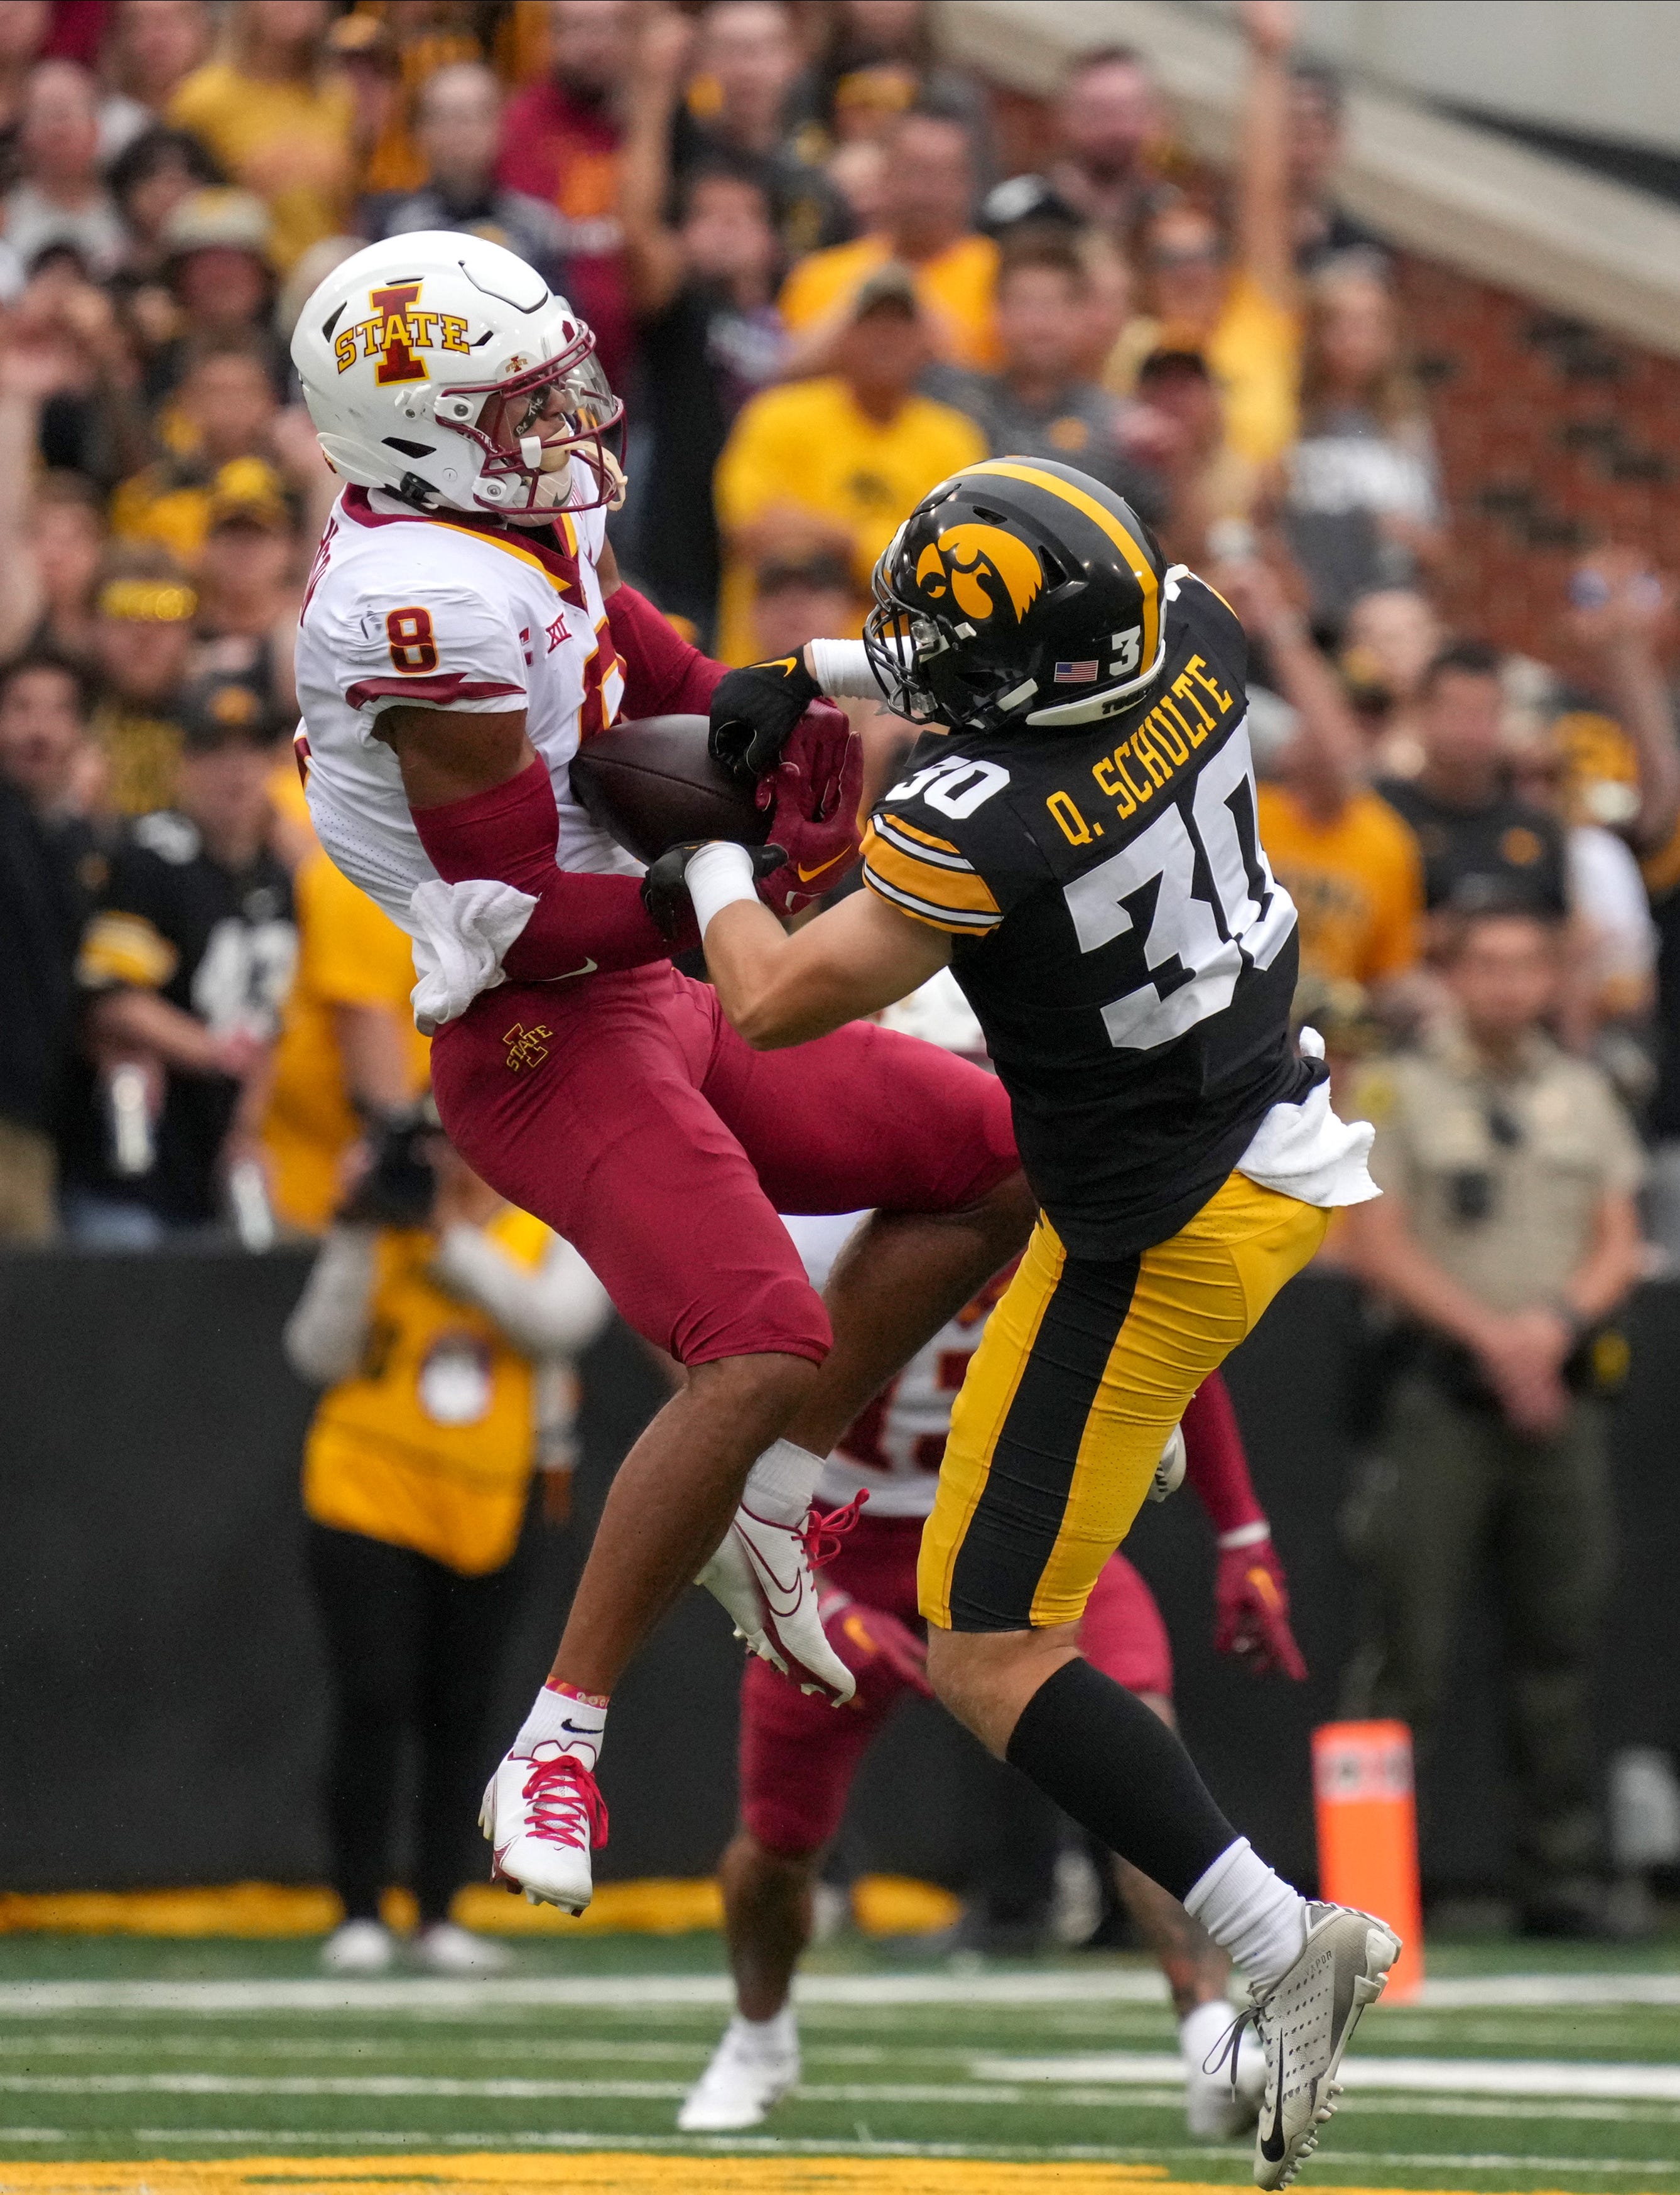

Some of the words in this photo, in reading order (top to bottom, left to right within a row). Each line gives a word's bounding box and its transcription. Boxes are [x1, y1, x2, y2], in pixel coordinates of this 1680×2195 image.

[335, 312, 470, 374] STATE
[369, 283, 430, 388] I
[516, 423, 528, 435] Be
[528, 398, 543, 416] The
[385, 606, 439, 676] 8
[545, 611, 572, 654] XII
[1109, 625, 1141, 676] 3
[1046, 791, 1103, 846] Q.
[1092, 654, 1234, 821] SCHULTE
[885, 756, 1010, 819] 30
[1063, 713, 1299, 1050] 30
[506, 1025, 553, 1071] STATE
